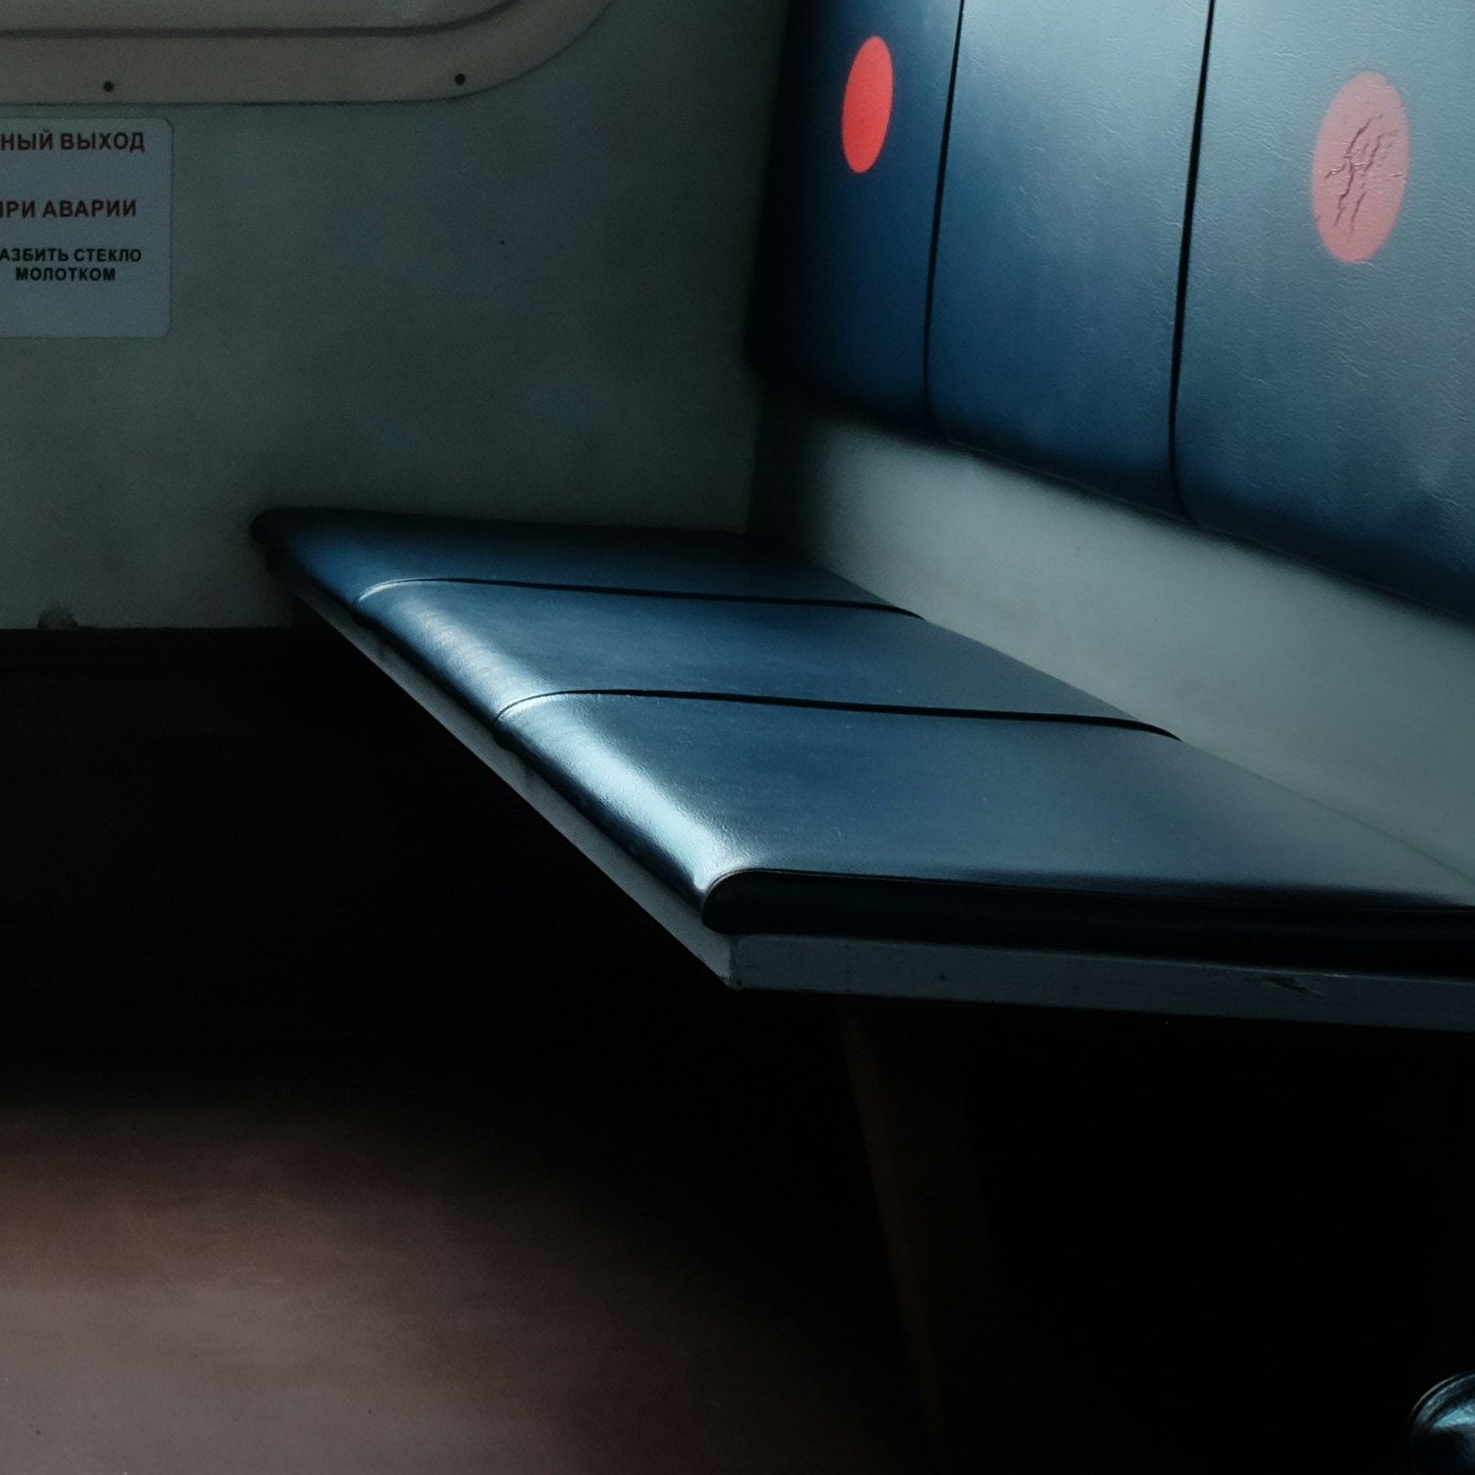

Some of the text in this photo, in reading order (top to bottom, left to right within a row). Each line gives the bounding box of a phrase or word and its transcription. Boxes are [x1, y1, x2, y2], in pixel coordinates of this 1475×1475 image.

[61, 132, 145, 153] ВЫХОД
[42, 199, 137, 218] АВАРИИ
[74, 248, 142, 263] СТЕКЛО
[16, 268, 116, 282] МОЛОТКОМ
